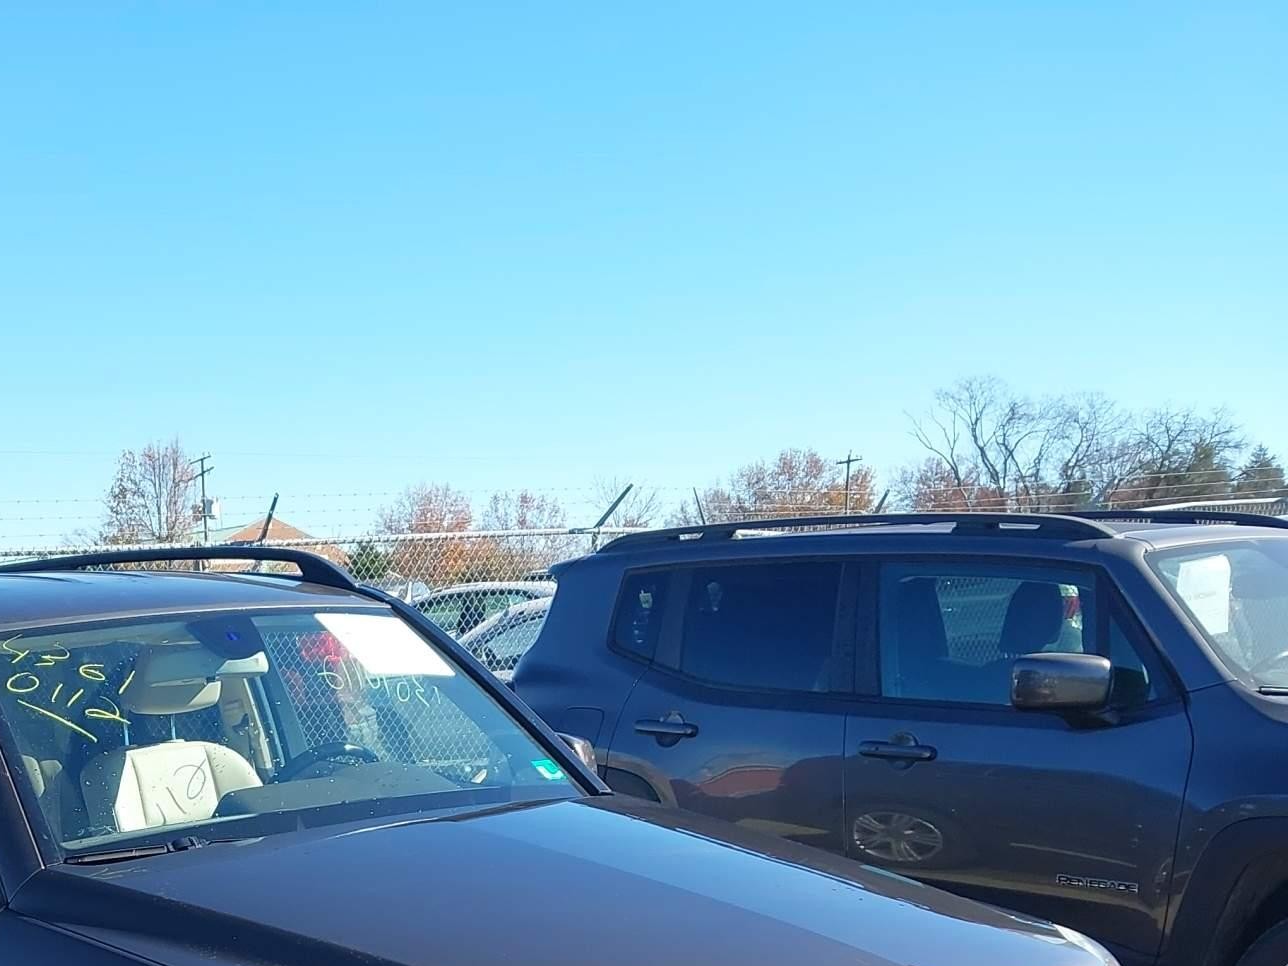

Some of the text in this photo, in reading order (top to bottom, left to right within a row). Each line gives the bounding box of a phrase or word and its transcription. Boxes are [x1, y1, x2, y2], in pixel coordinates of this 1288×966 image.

[2, 633, 136, 695] 4361
[6, 671, 132, 725] 0112
[1055, 872, 1139, 894] RENEGADE
